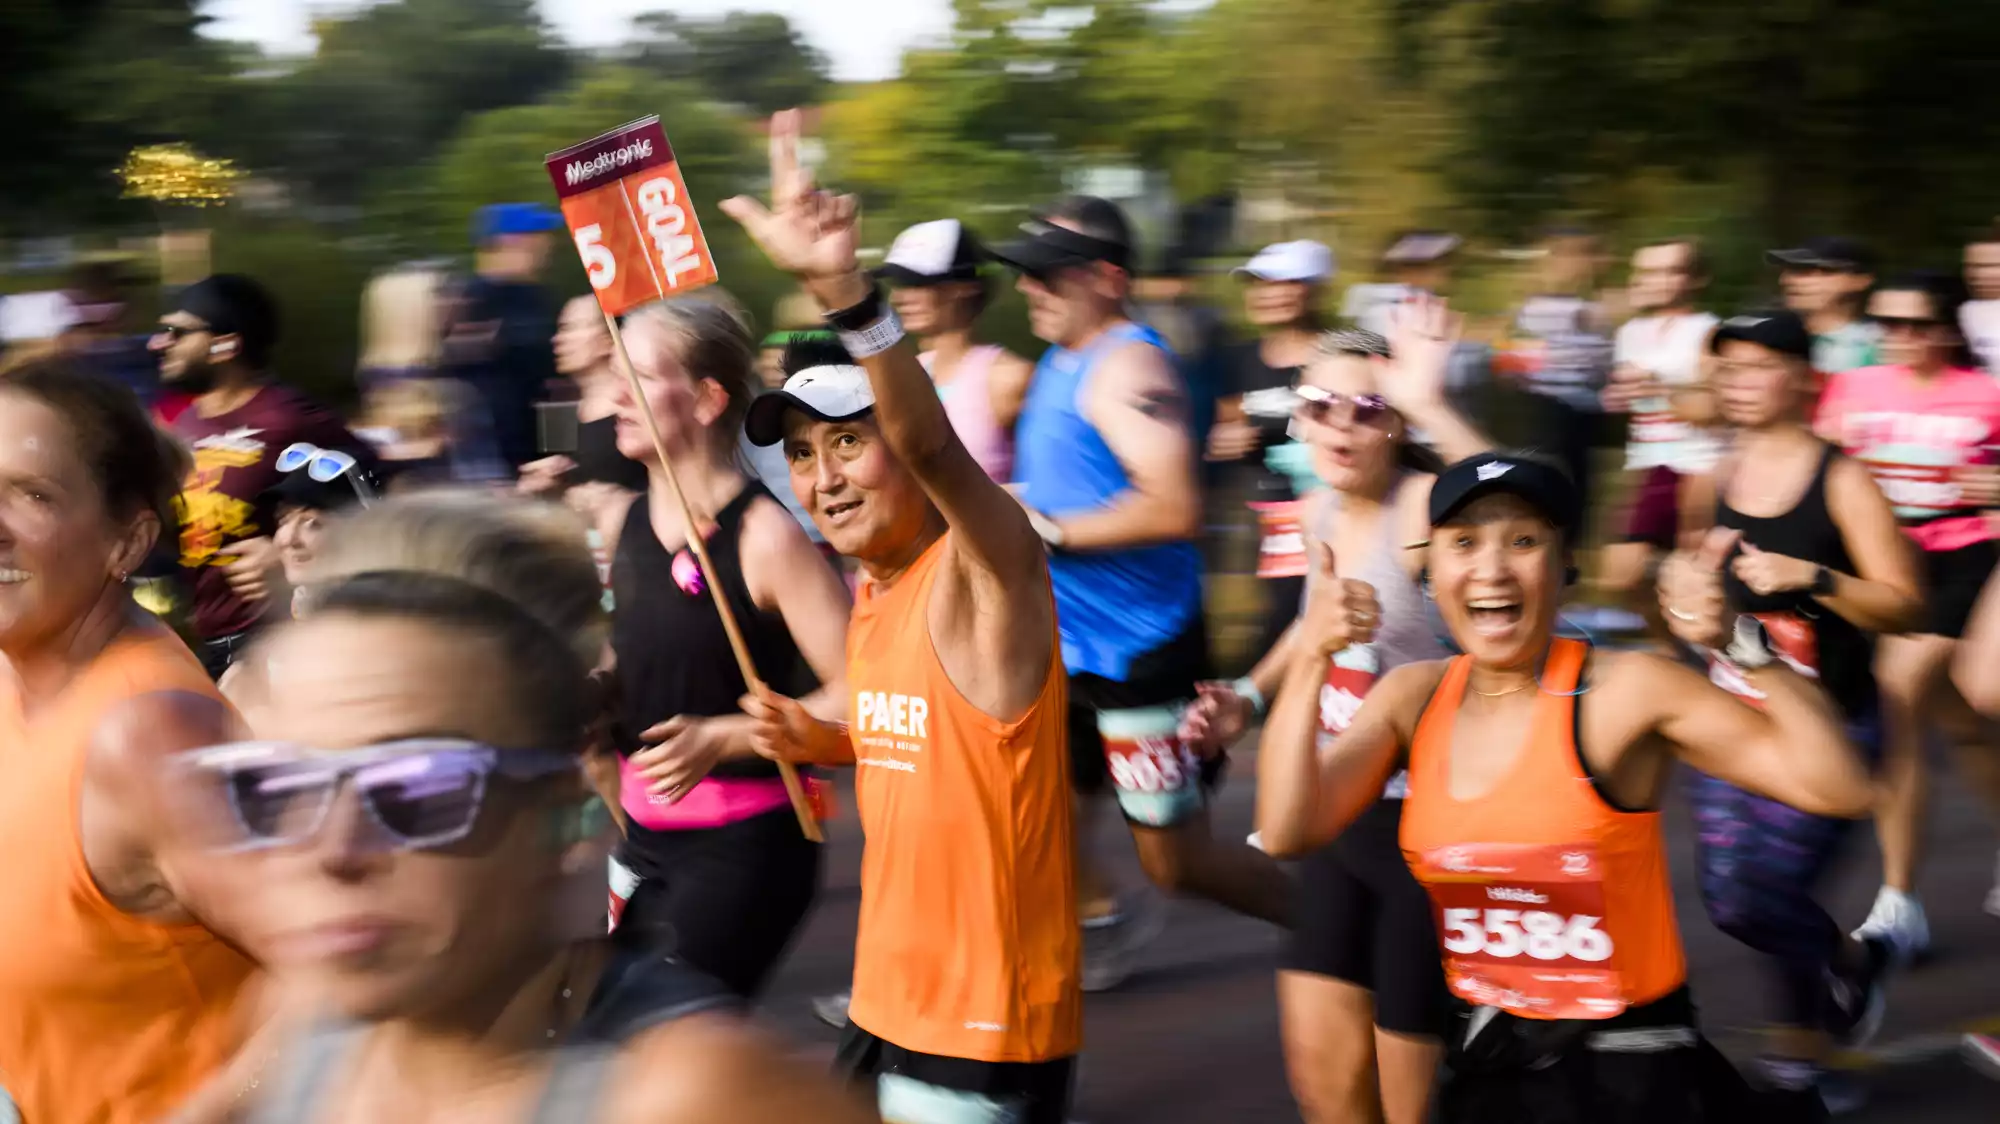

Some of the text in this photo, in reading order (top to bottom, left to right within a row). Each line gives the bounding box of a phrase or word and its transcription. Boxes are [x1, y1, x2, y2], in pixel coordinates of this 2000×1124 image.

[565, 138, 653, 186] Medtronic
[574, 223, 616, 290] 5
[638, 177, 699, 288] GOAL
[1443, 907, 1615, 962] 5586
